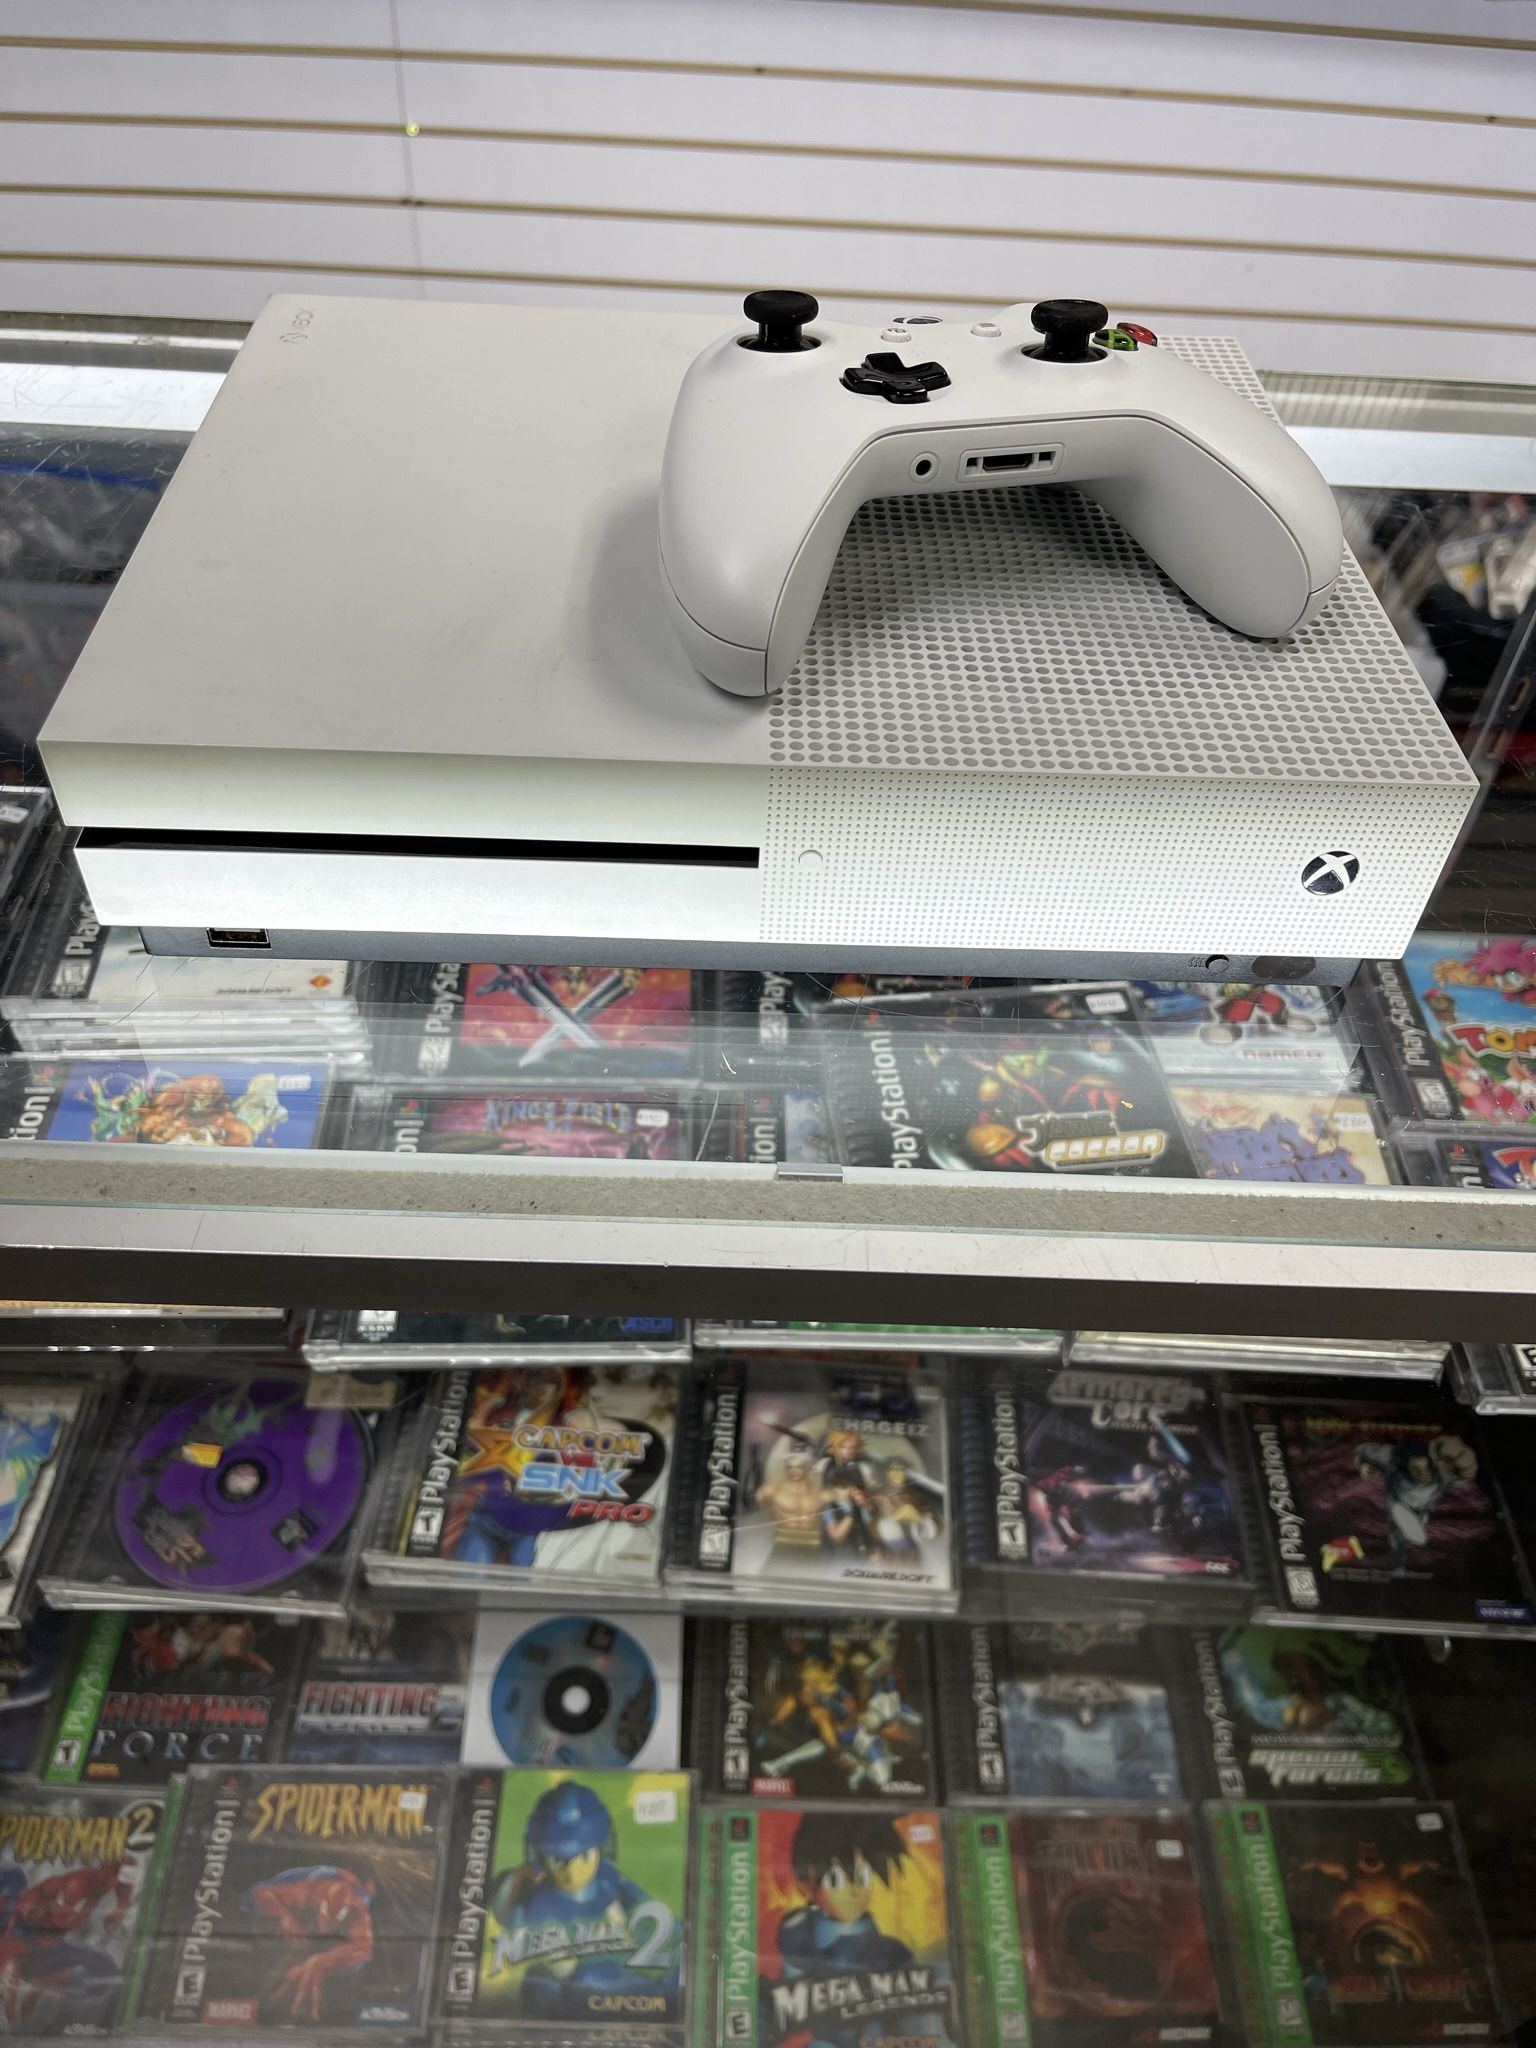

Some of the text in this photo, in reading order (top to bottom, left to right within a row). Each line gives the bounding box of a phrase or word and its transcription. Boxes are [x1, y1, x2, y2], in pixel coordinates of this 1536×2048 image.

[761, 972, 793, 1016] Play
[1377, 961, 1431, 1067] PlayStation
[419, 1370, 472, 1500] PlayStation
[514, 1426, 645, 1458] CAPCOM
[520, 1463, 632, 1498] SNK
[704, 1394, 738, 1521] PlayStation
[994, 1391, 1028, 1520] PlayStation
[568, 1500, 655, 1522] PRO
[1259, 1431, 1306, 1560] PlayStation
[304, 1682, 438, 1716] FIGHTING
[724, 1622, 754, 1744] PlayStation
[971, 1627, 1008, 1748] PlayStation
[1196, 1640, 1237, 1764] PlayStation
[92, 1728, 263, 1761] FORCE
[127, 1805, 156, 1846] 2
[182, 1809, 237, 1961] PlayStation
[453, 1808, 494, 1958] PlayStation
[489, 1926, 571, 1978] MEGA
[626, 1900, 676, 1968] 2
[726, 1851, 758, 2000] PlayStation
[985, 1856, 1021, 2002] PlayStation
[1250, 1842, 1295, 1988] PlayStation
[588, 1995, 667, 2012] CAPCOM
[772, 1969, 931, 2033] MEGA MAN
[840, 1991, 948, 2019] LEGENDS
